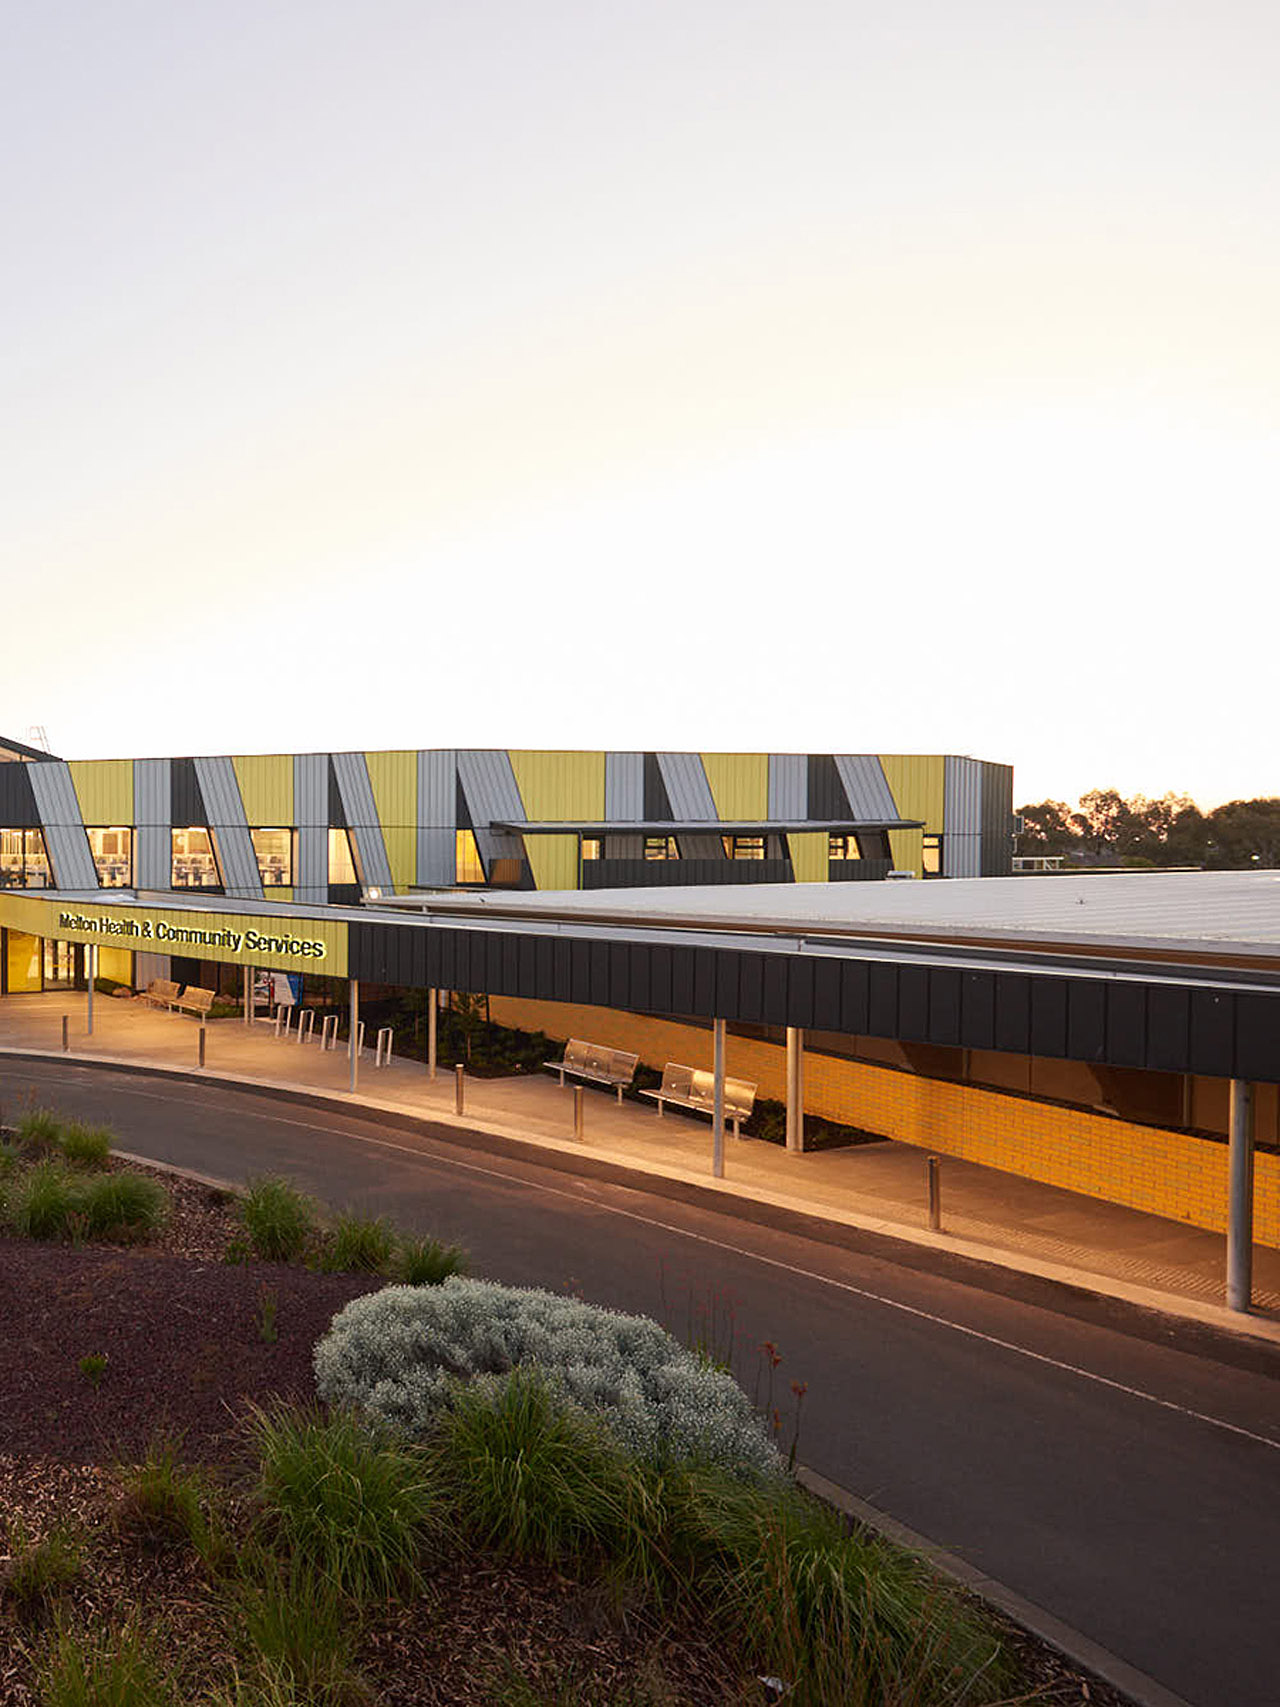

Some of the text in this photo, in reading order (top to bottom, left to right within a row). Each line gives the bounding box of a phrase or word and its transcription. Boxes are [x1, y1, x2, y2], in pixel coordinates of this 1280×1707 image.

[59, 912, 324, 957] Melton Health & Community Services
